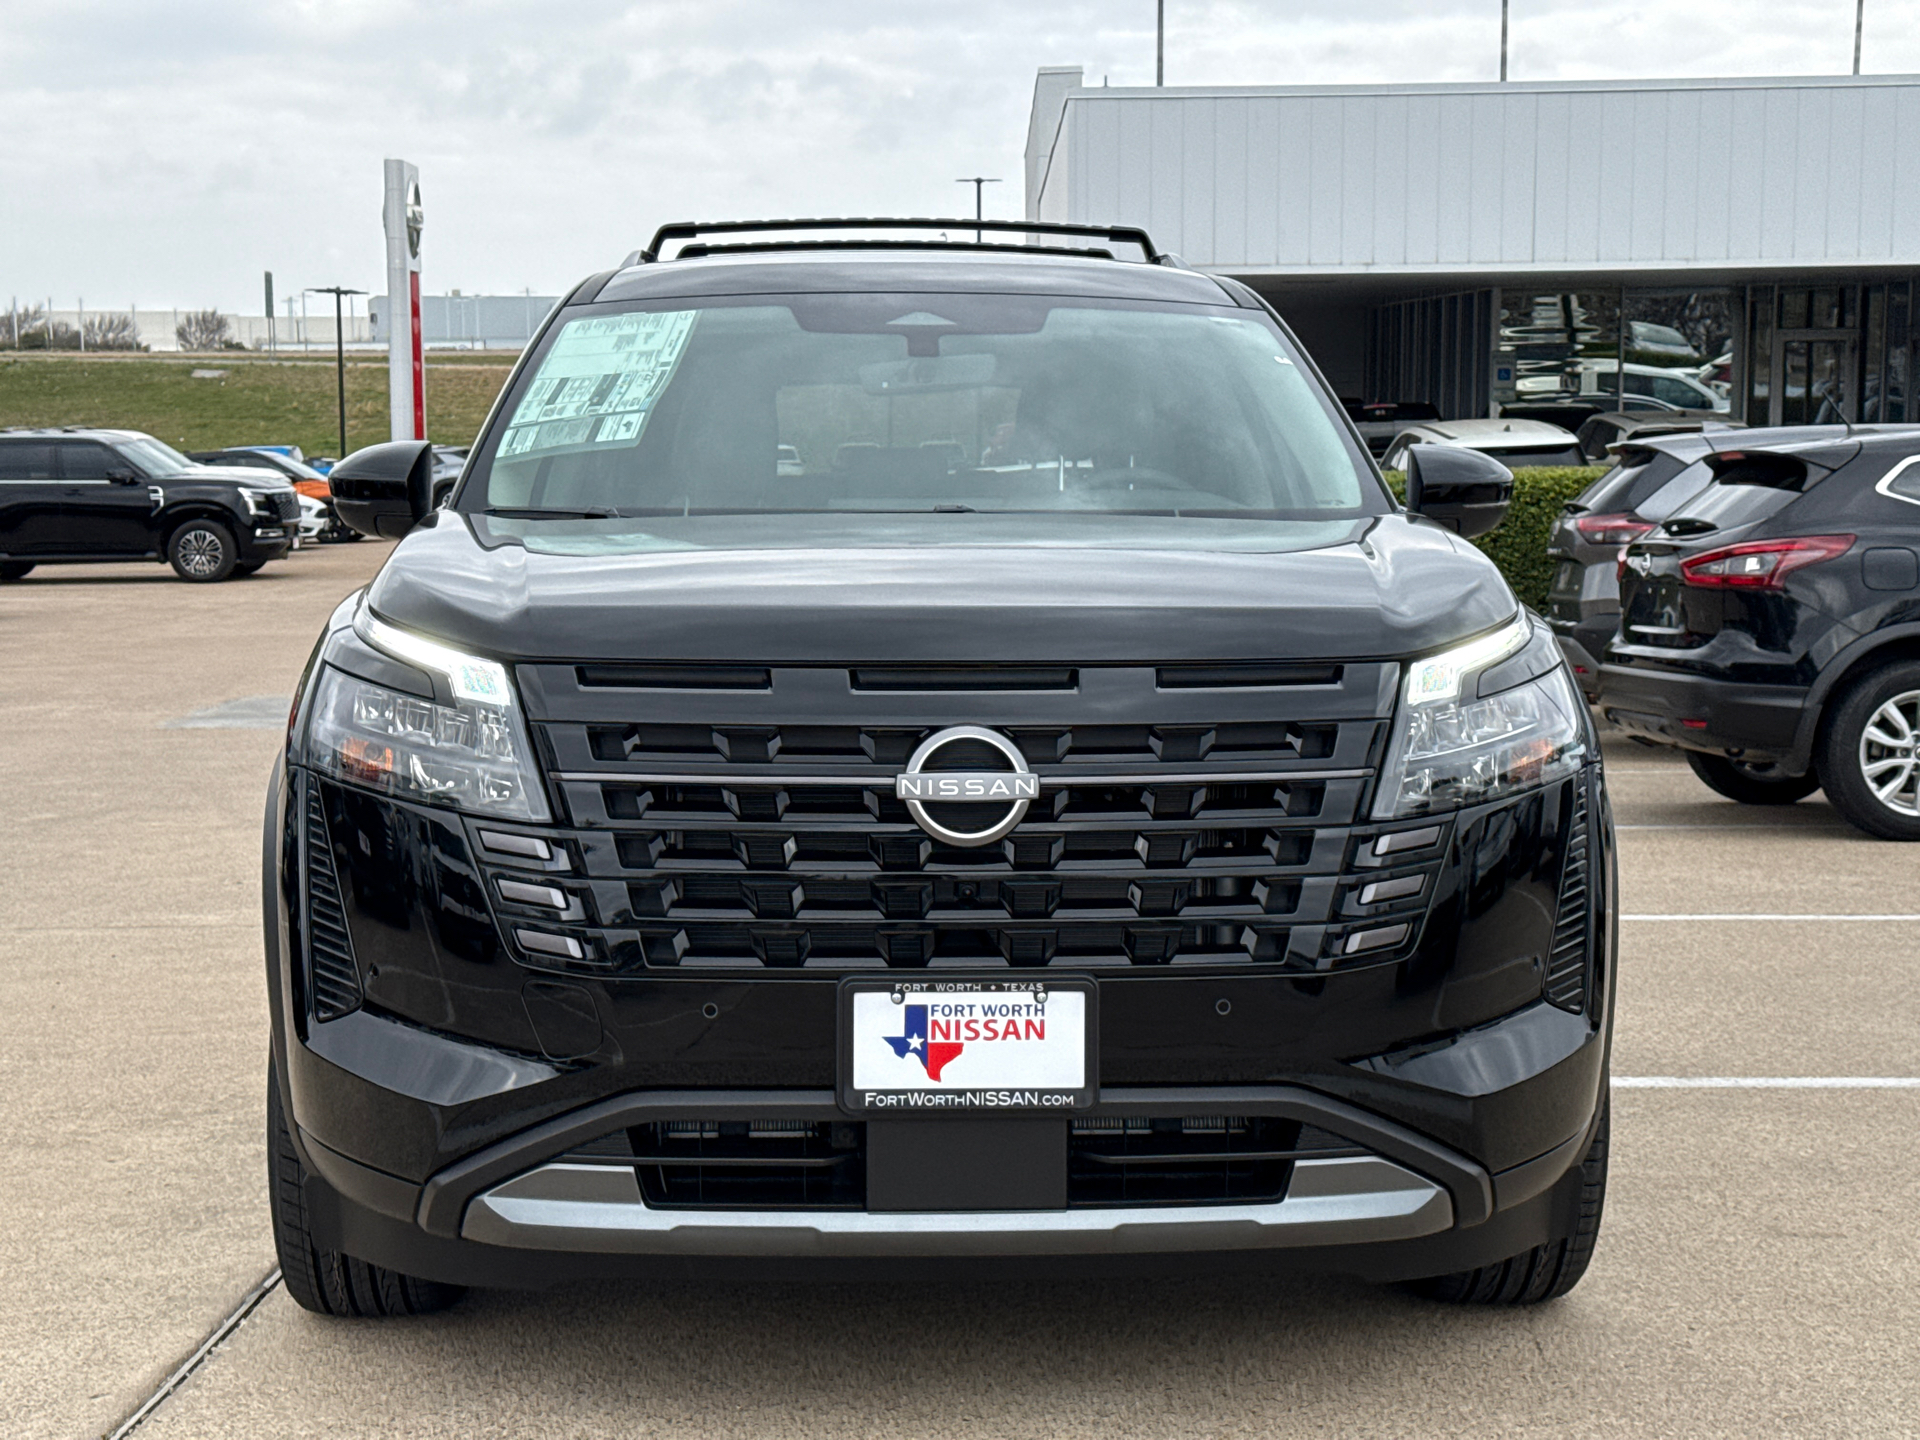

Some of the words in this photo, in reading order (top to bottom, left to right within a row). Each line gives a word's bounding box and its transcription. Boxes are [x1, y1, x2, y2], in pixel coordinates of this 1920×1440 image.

[901, 778, 1035, 796] NISSAN
[895, 983, 929, 992] FORT
[935, 983, 982, 992] WORTH
[1002, 983, 1044, 992] TEXAS
[931, 1004, 976, 1017] FORT
[981, 1004, 1045, 1017] WORTH
[931, 1019, 1045, 1041] NISSAN
